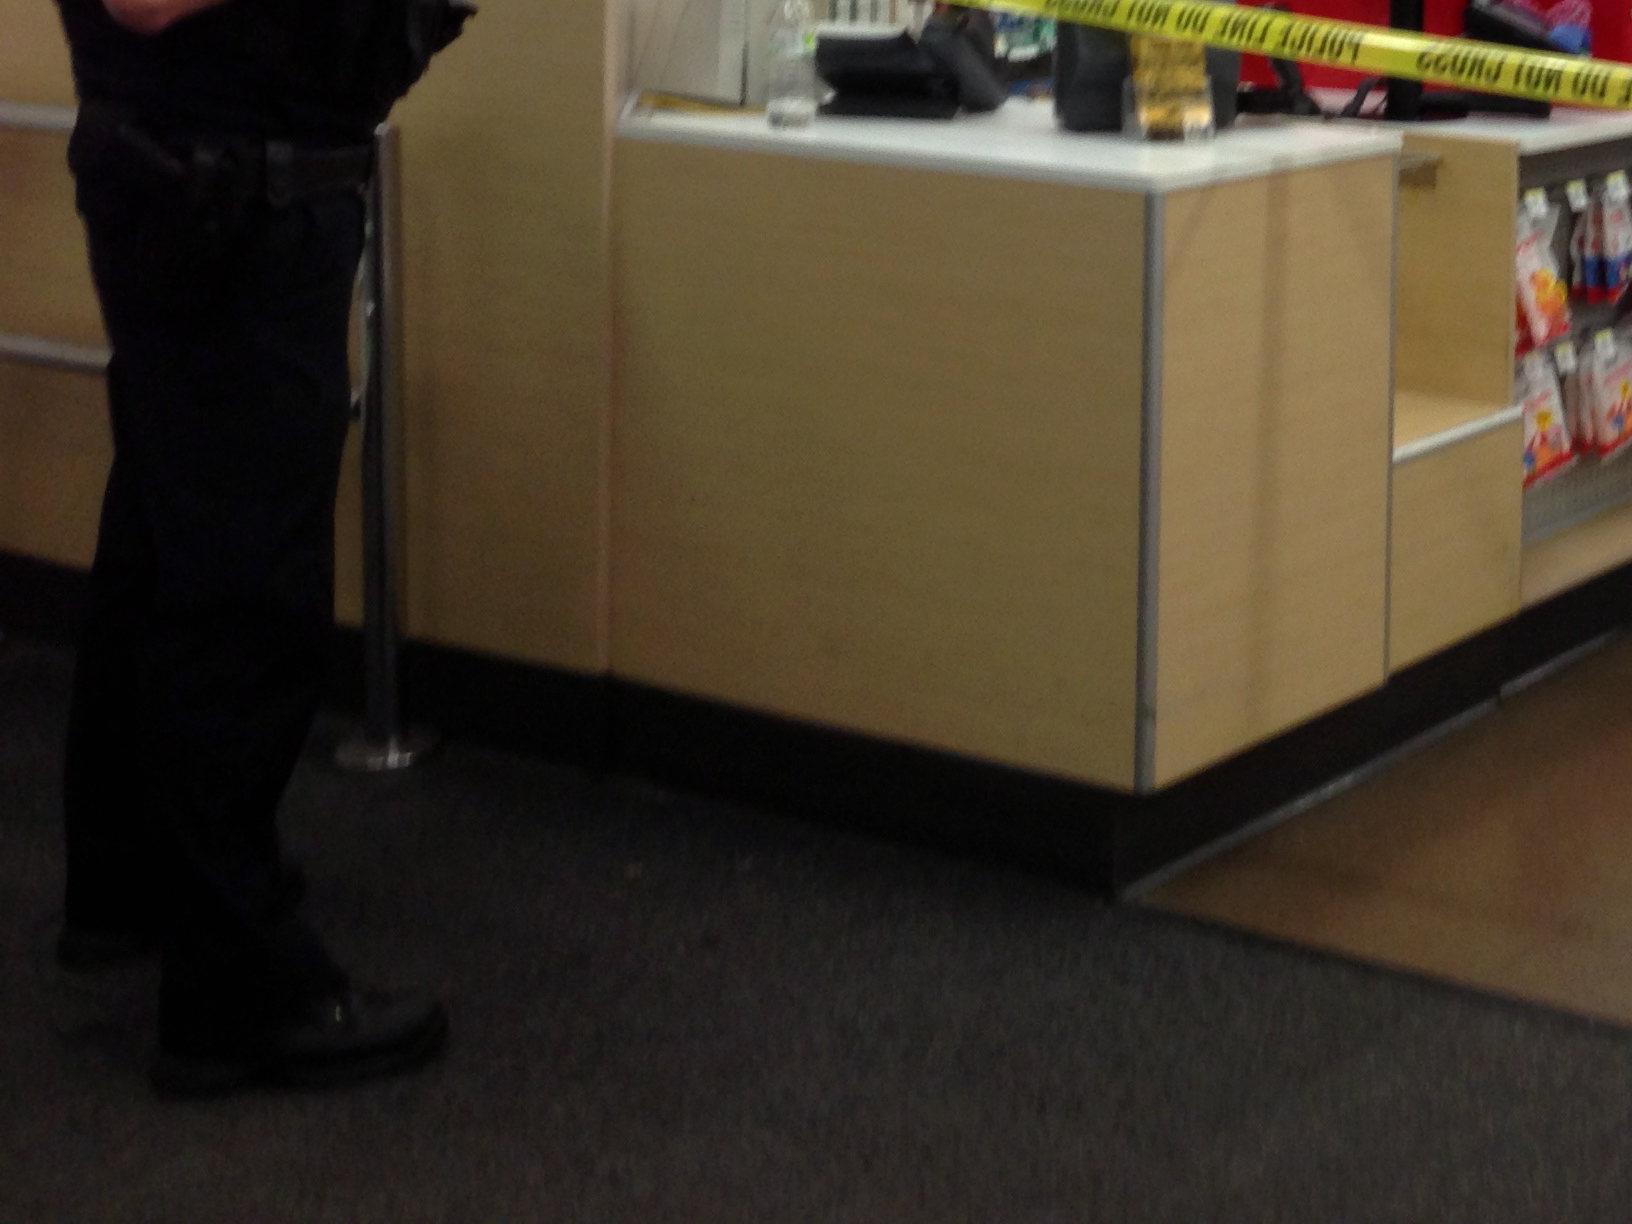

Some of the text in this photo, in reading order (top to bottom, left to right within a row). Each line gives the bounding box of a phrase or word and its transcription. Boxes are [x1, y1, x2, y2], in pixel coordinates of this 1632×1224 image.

[1125, 0, 1171, 27] NOT
[1174, 7, 1209, 33] DO
[1218, 13, 1271, 46] LINE
[1279, 21, 1362, 64] POLICE
[1415, 45, 1506, 84] CROSS
[1513, 58, 1564, 94] NOT
[1570, 67, 1611, 99] DO
